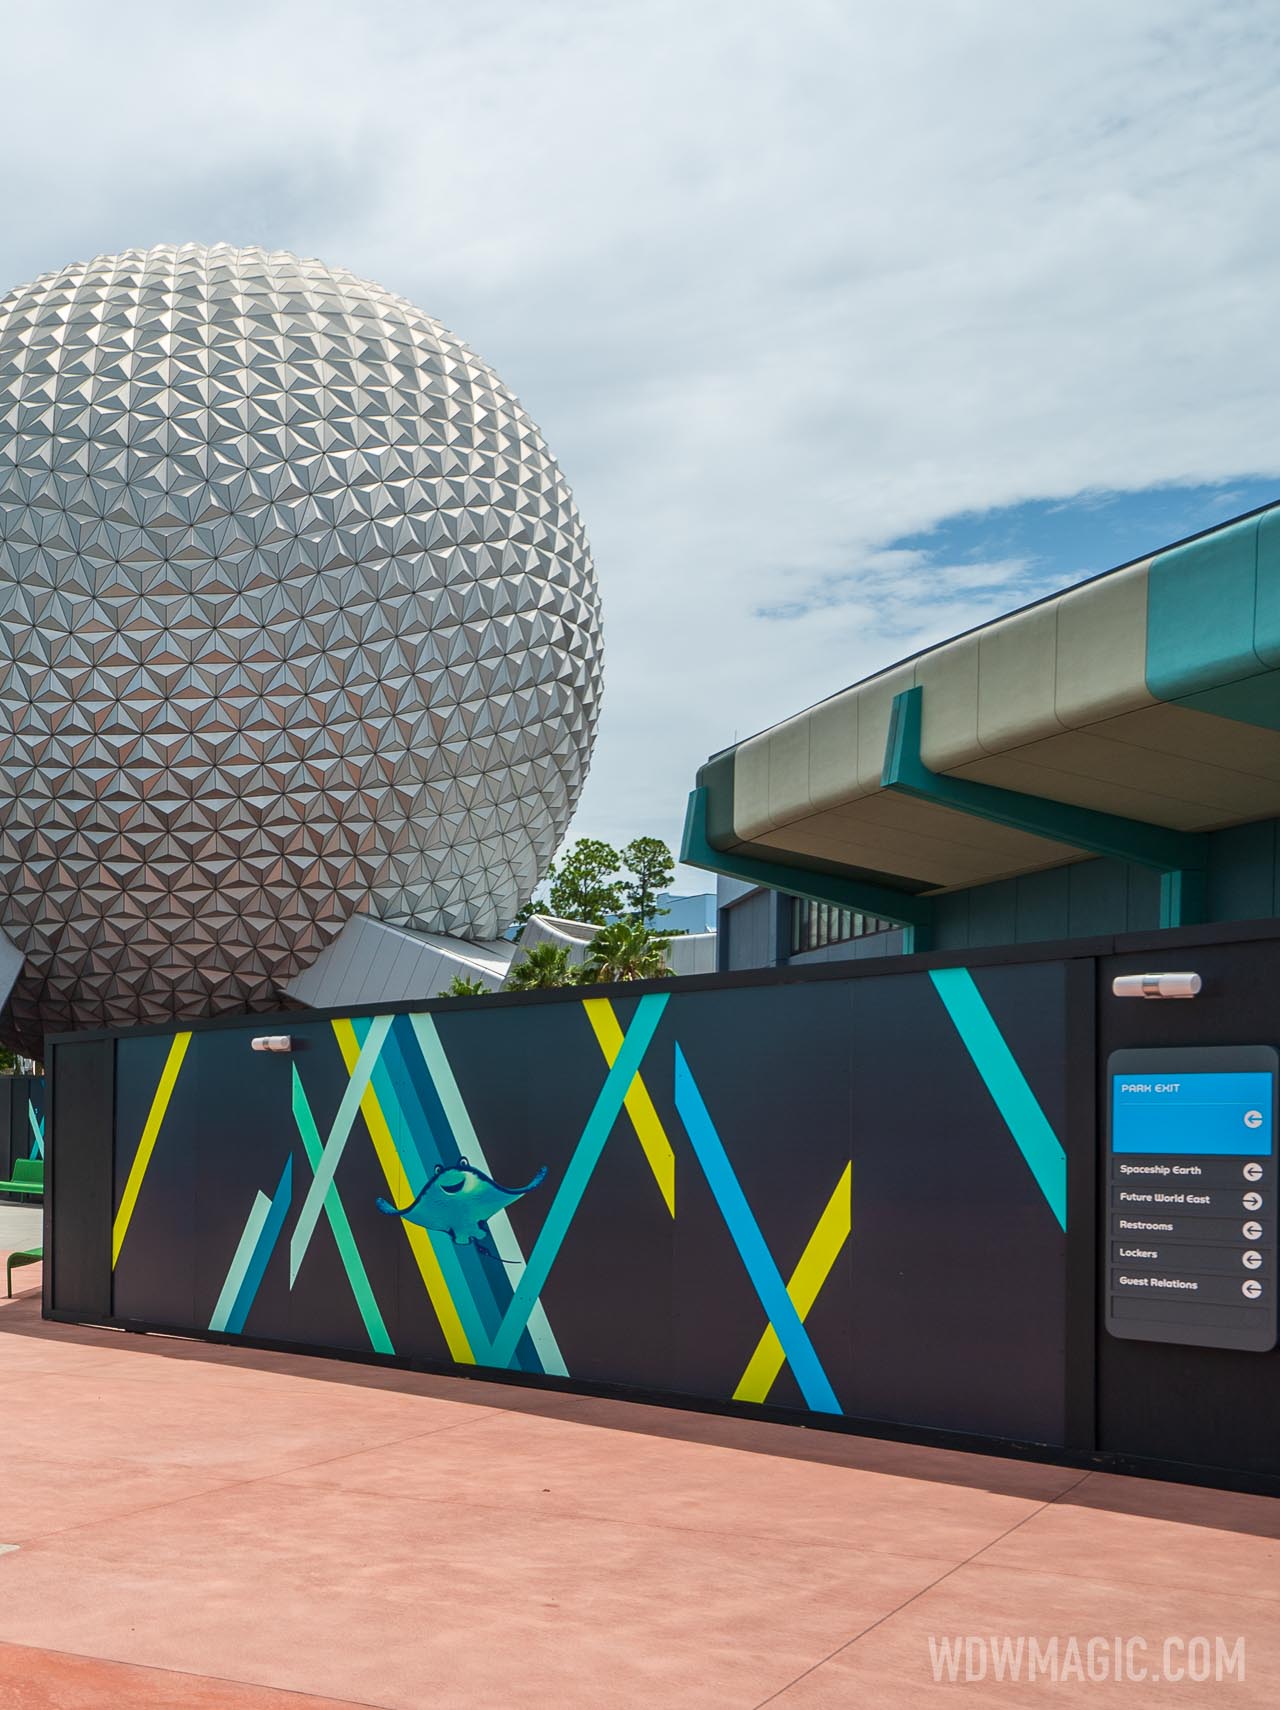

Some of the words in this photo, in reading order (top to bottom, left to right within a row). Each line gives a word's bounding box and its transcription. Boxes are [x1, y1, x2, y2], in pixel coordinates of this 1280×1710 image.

[1121, 1083, 1152, 1093] PARK
[1154, 1083, 1180, 1093] EXIT
[1120, 1164, 1170, 1176] Spaceship
[1172, 1165, 1201, 1175] Earth
[1120, 1192, 1153, 1202] Future
[1154, 1193, 1184, 1203] World
[1186, 1194, 1210, 1204] East
[1119, 1220, 1173, 1231] Restrooms
[1119, 1248, 1158, 1259] Lockers
[1119, 1276, 1148, 1286] Guest
[1150, 1278, 1198, 1290] Relations
